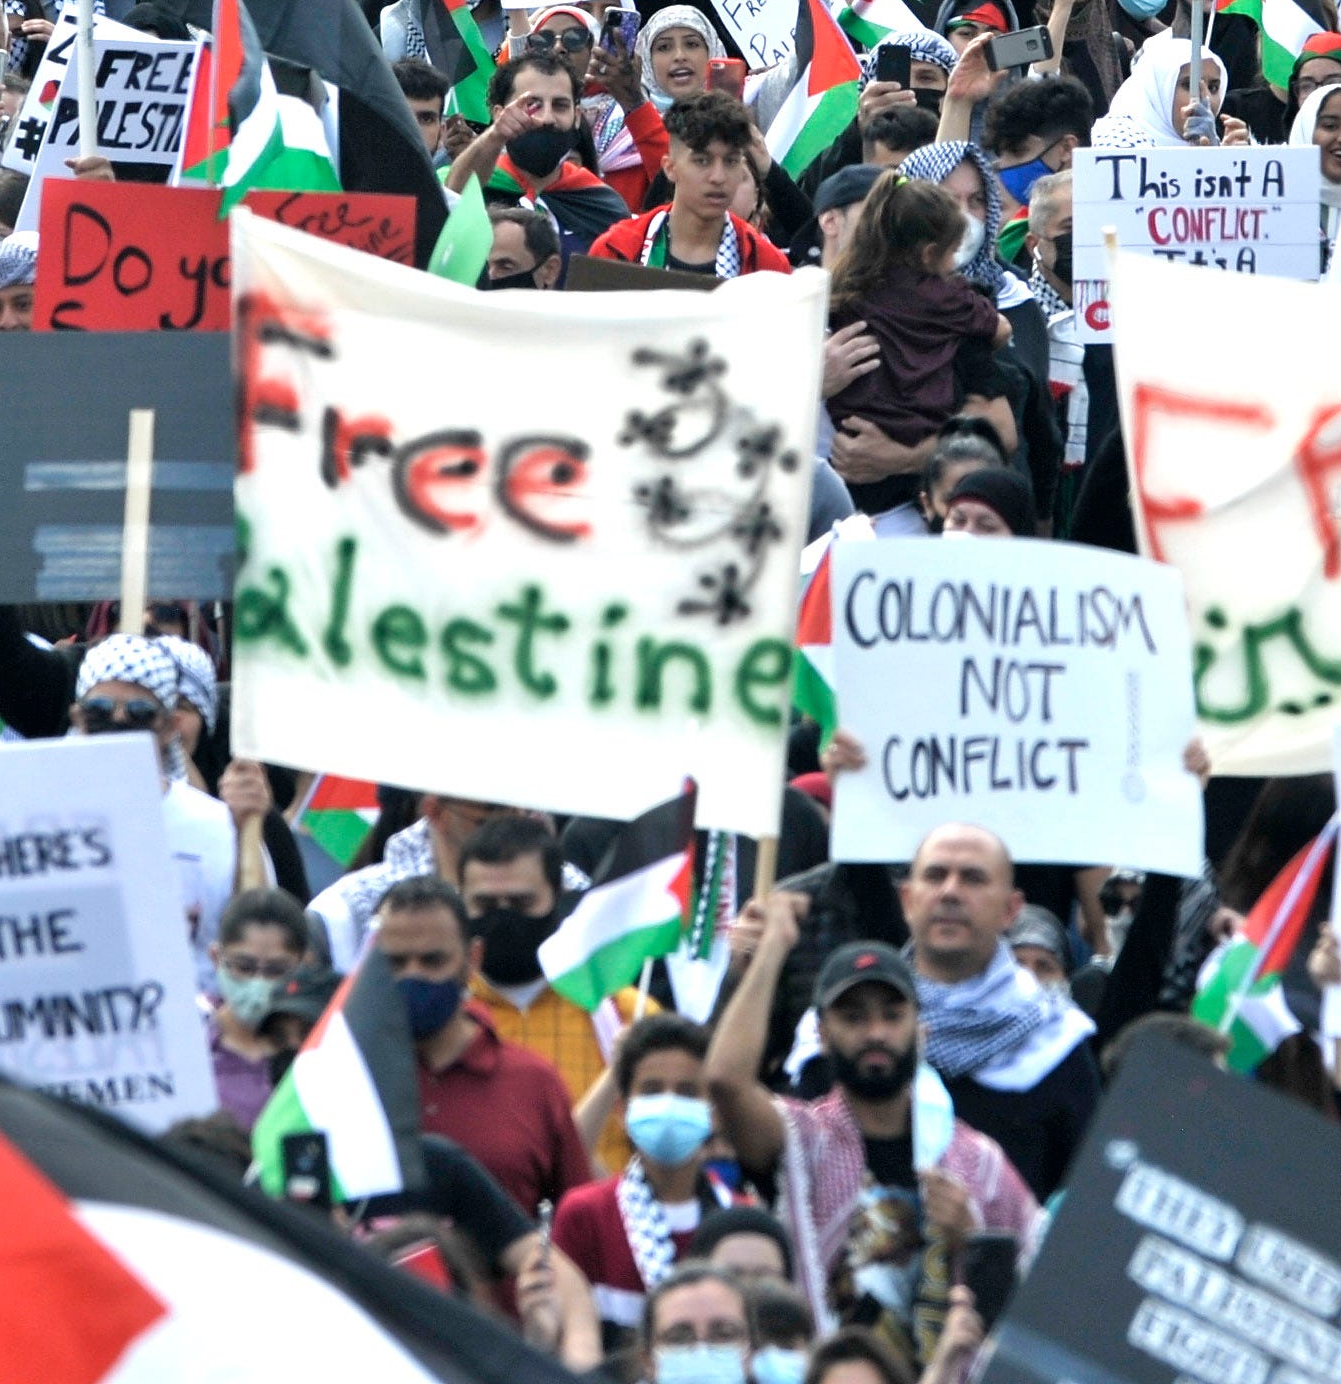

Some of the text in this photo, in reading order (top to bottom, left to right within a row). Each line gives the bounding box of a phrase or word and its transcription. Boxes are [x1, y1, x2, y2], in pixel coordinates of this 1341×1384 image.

[97, 48, 192, 93] FREE
[1095, 154, 1285, 201] This isn't A
[63, 202, 153, 297] Do
[234, 293, 592, 544] Free
[845, 569, 1157, 655] COLONIALISM
[960, 656, 1066, 723] NOT
[881, 734, 1089, 803] CONFLICT
